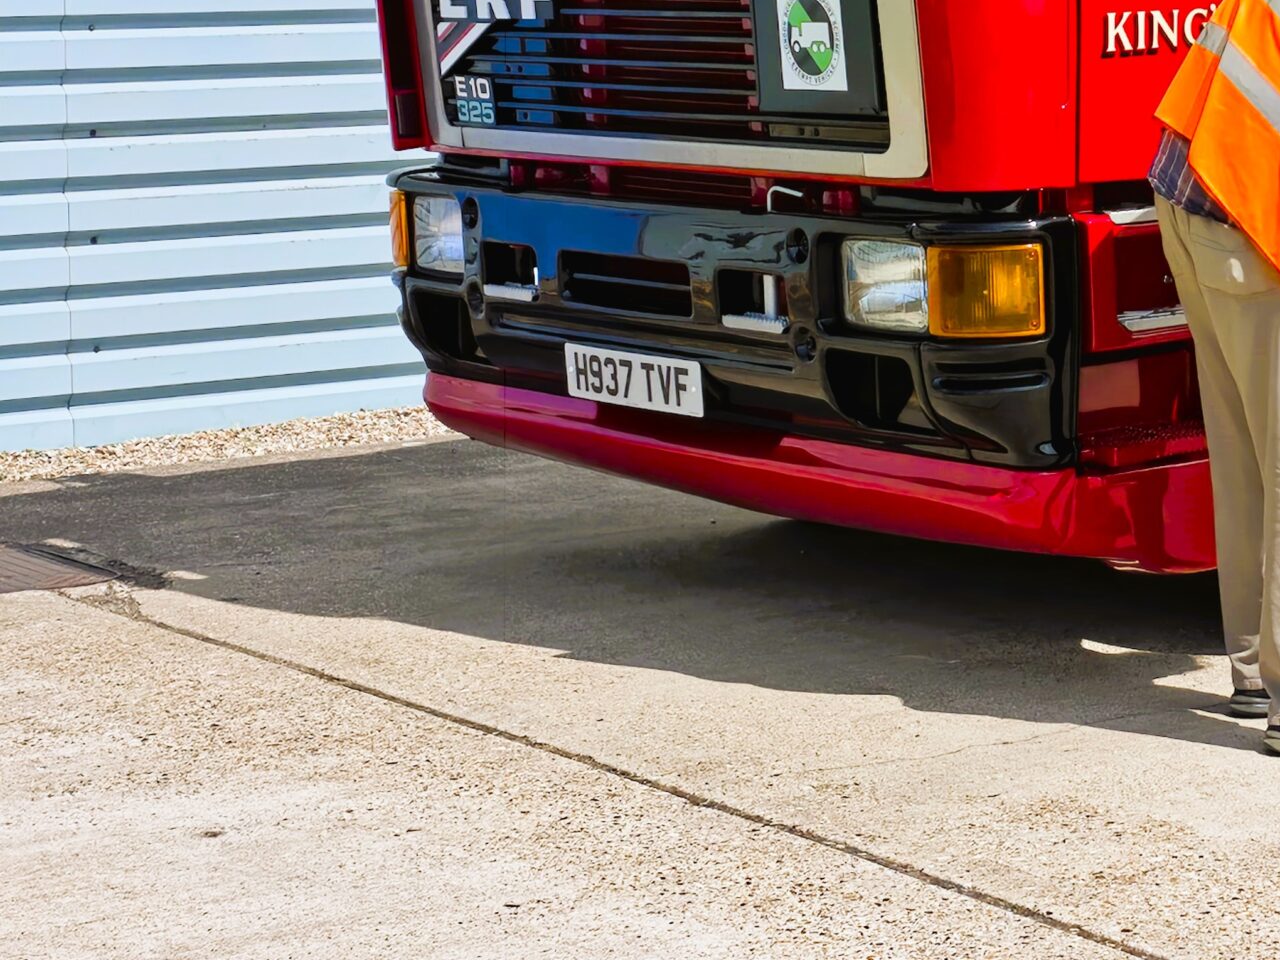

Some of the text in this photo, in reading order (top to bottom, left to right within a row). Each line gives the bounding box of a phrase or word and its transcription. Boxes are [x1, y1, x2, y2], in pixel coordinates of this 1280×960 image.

[1106, 2, 1217, 53] KING'
[454, 75, 490, 99] E10
[456, 99, 495, 124] 325
[574, 351, 689, 407] H937 TVF
